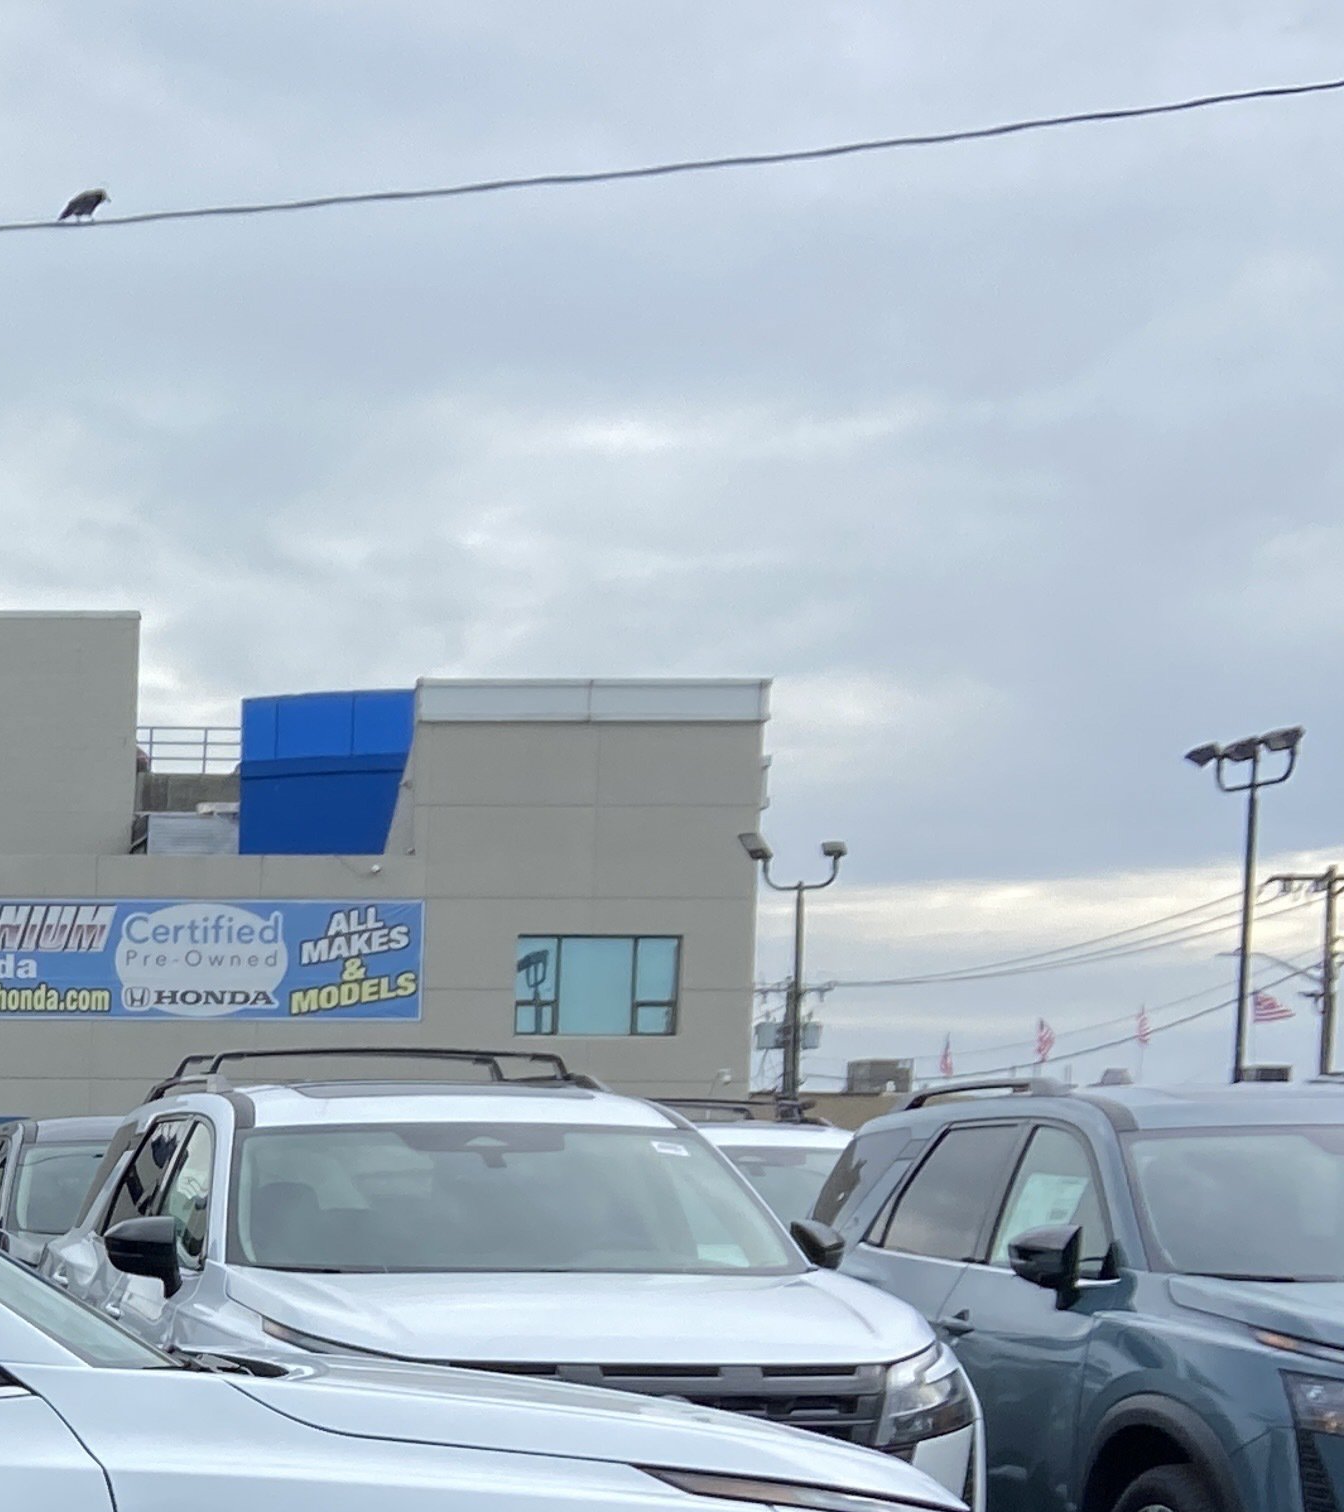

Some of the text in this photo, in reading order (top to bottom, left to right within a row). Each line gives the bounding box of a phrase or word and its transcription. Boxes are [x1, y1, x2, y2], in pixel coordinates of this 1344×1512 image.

[125, 911, 280, 945] Certified
[326, 906, 384, 937] ALL
[125, 949, 278, 968] Pre-Owned
[301, 924, 410, 966] MAKES
[342, 956, 367, 981] &
[153, 989, 275, 1006] HONDA
[289, 971, 417, 1015] MODELS
